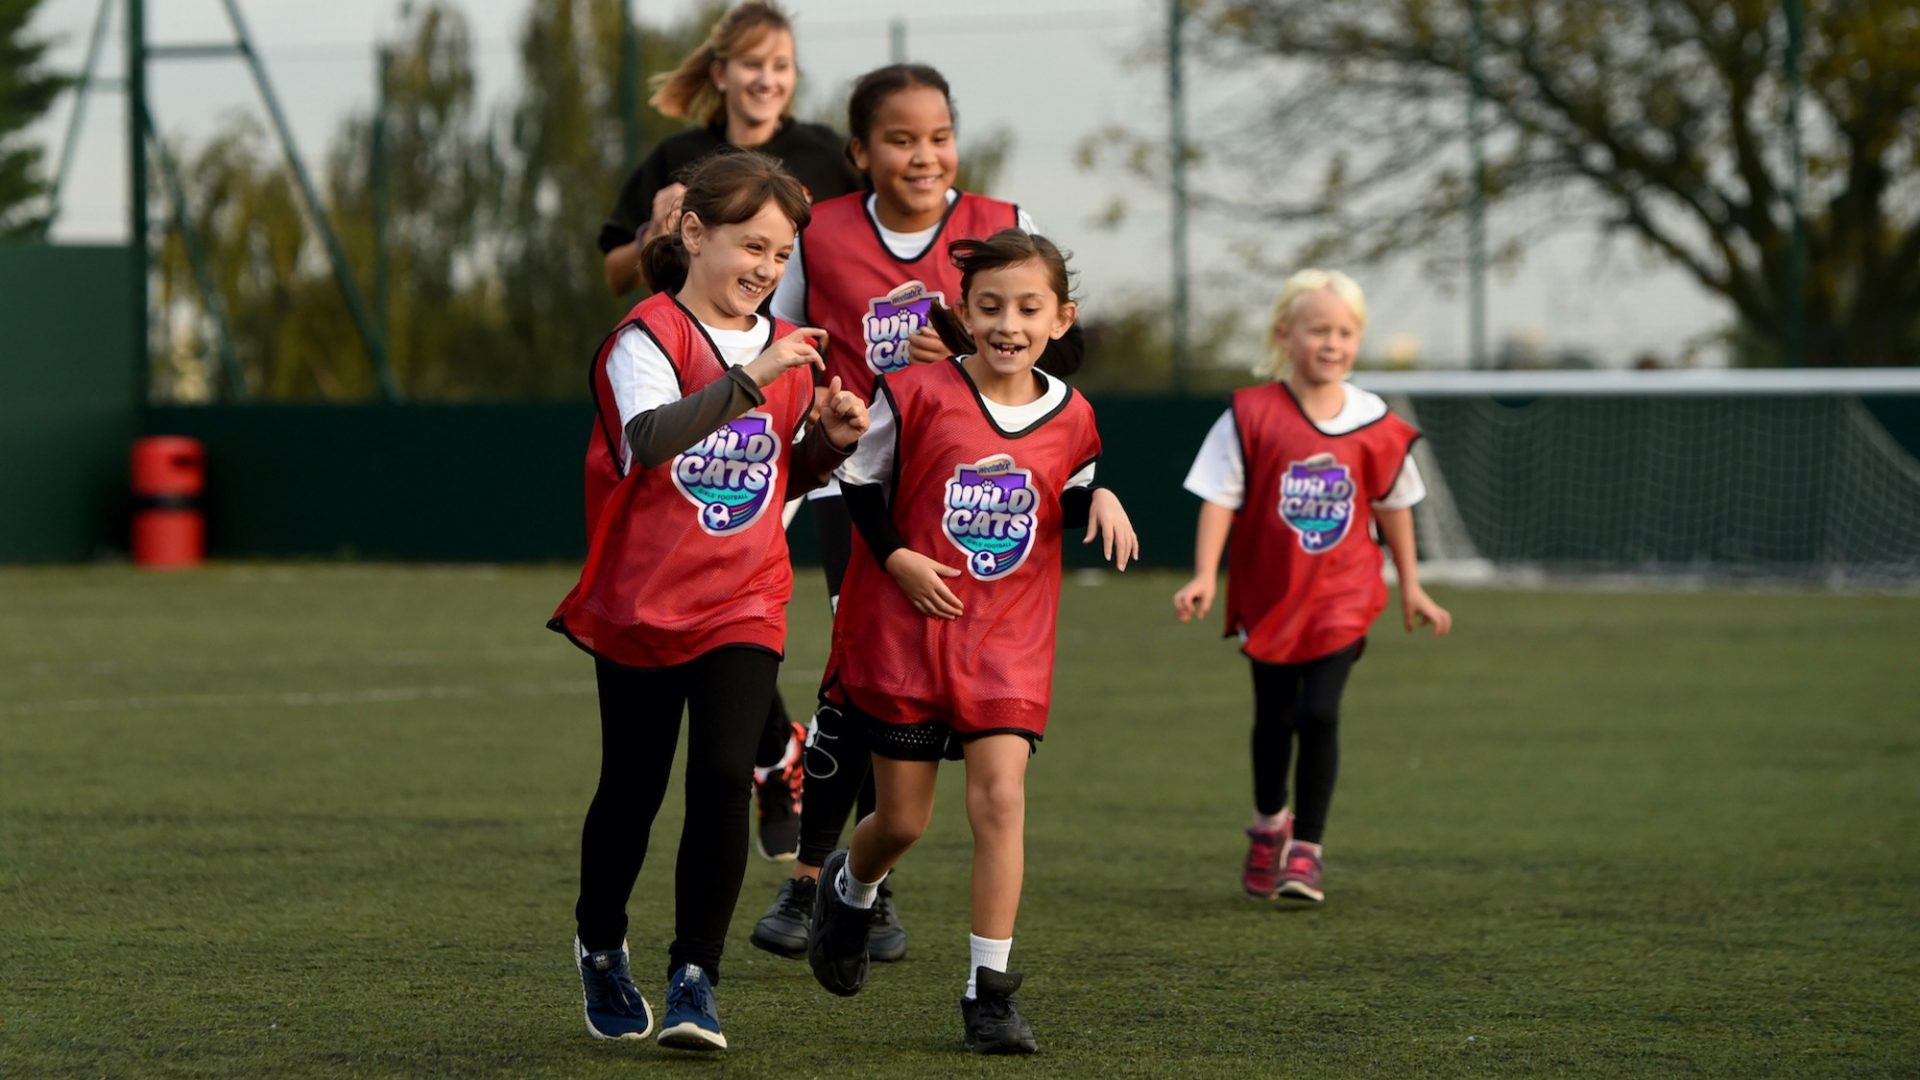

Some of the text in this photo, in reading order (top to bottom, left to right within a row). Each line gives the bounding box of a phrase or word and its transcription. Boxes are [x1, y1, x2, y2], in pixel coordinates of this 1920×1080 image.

[868, 309, 922, 341] WiL
[871, 340, 911, 367] CA
[678, 455, 770, 491] CATS
[1284, 498, 1348, 519] CATS
[948, 509, 1030, 540] CATS
